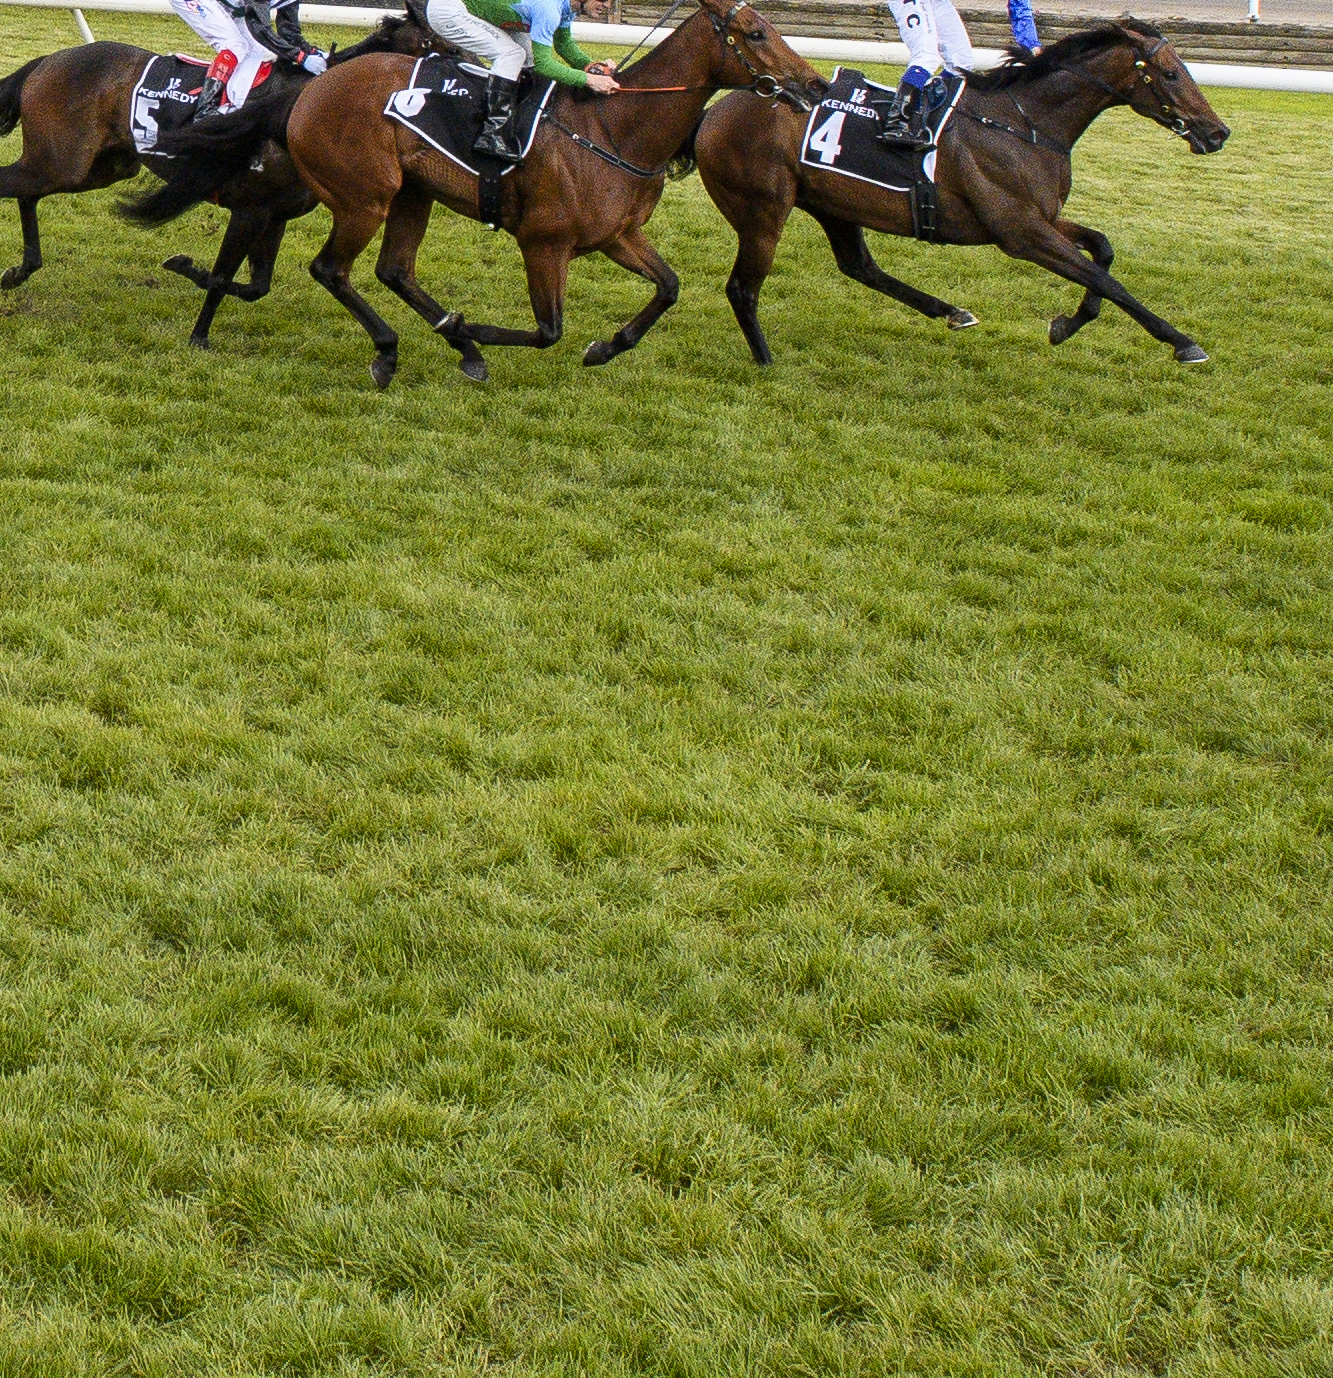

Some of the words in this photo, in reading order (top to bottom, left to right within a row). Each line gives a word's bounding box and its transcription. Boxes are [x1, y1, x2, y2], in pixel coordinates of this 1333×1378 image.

[138, 86, 199, 104] KENNEDY
[394, 88, 433, 117] 6
[134, 95, 160, 150] 5
[810, 110, 847, 164] 4
